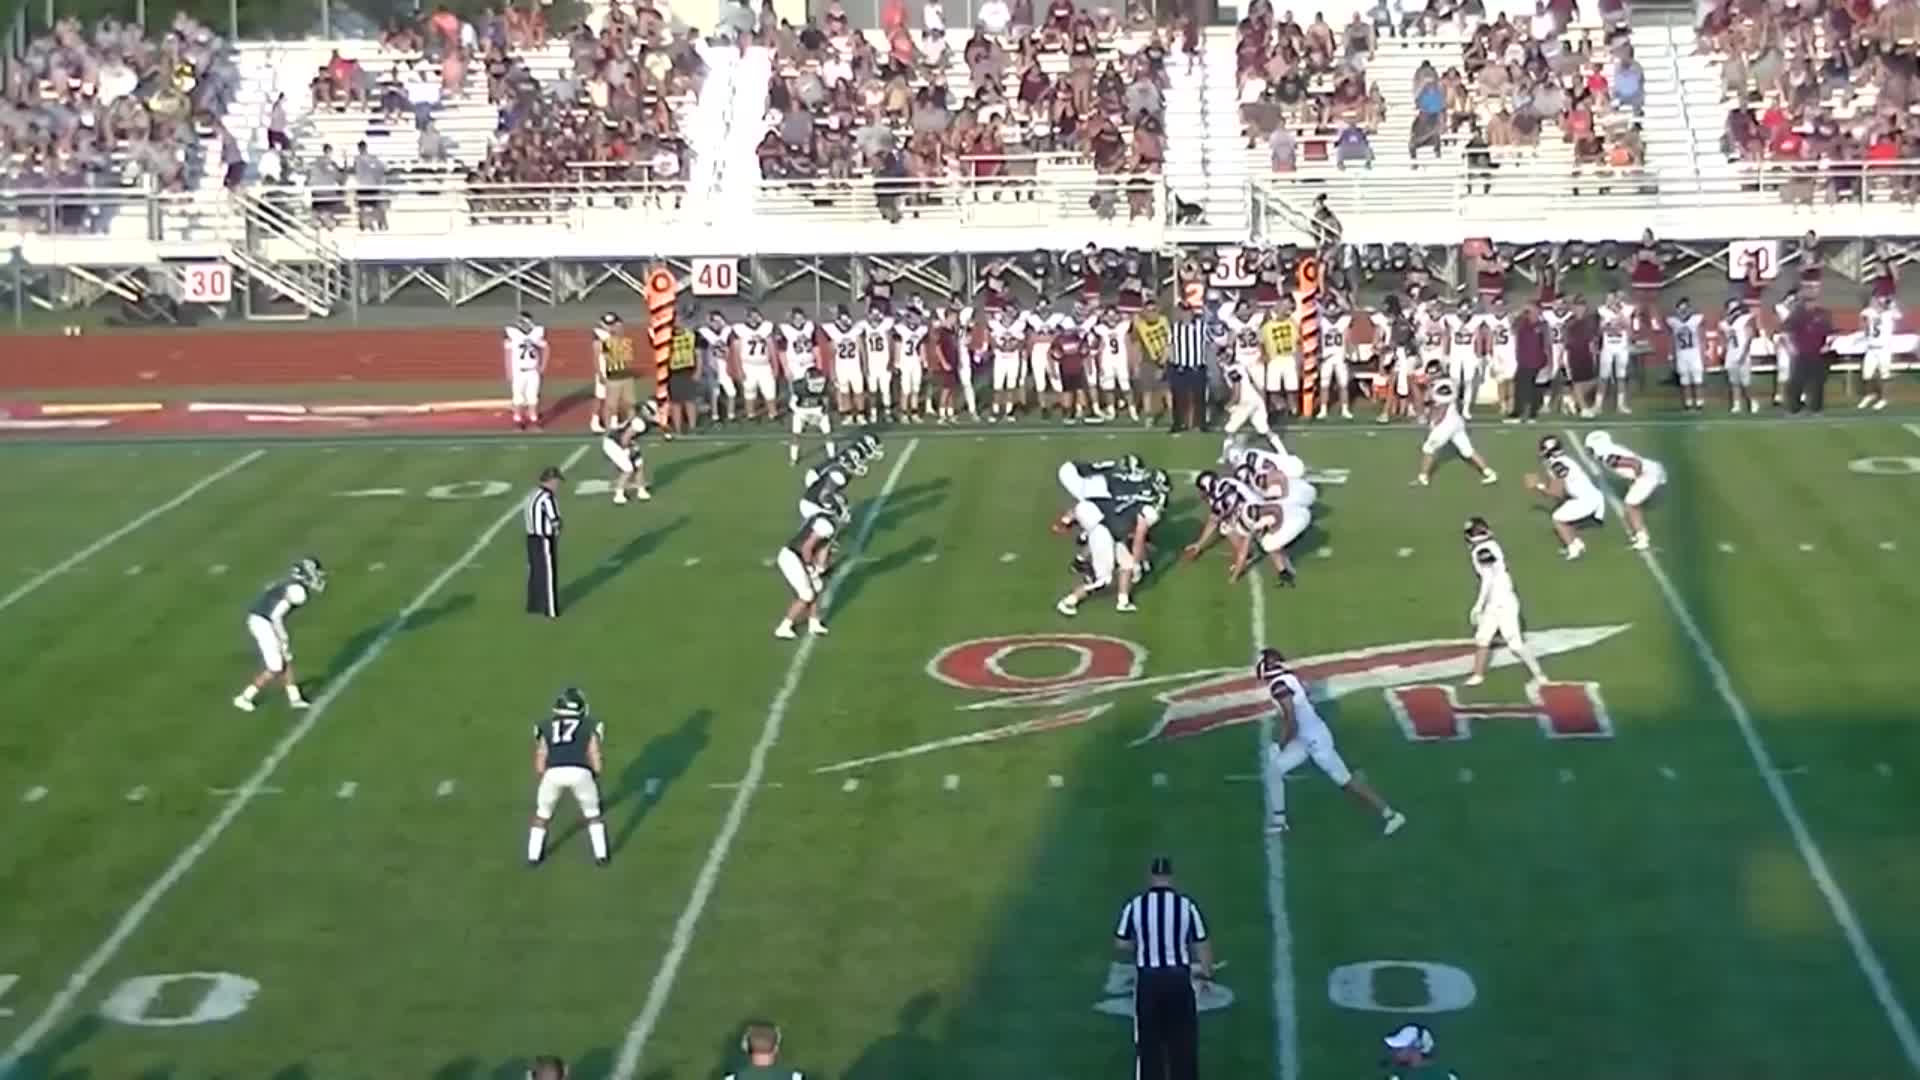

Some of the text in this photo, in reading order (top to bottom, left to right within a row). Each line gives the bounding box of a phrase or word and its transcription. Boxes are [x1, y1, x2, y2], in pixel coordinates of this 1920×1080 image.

[698, 263, 731, 289] 40
[1216, 255, 1249, 279] 50
[192, 271, 225, 296] 30
[747, 338, 768, 356] 77
[837, 341, 856, 359] 22
[868, 335, 884, 352] 16
[1109, 337, 1119, 355] 9
[551, 719, 581, 744] 17
